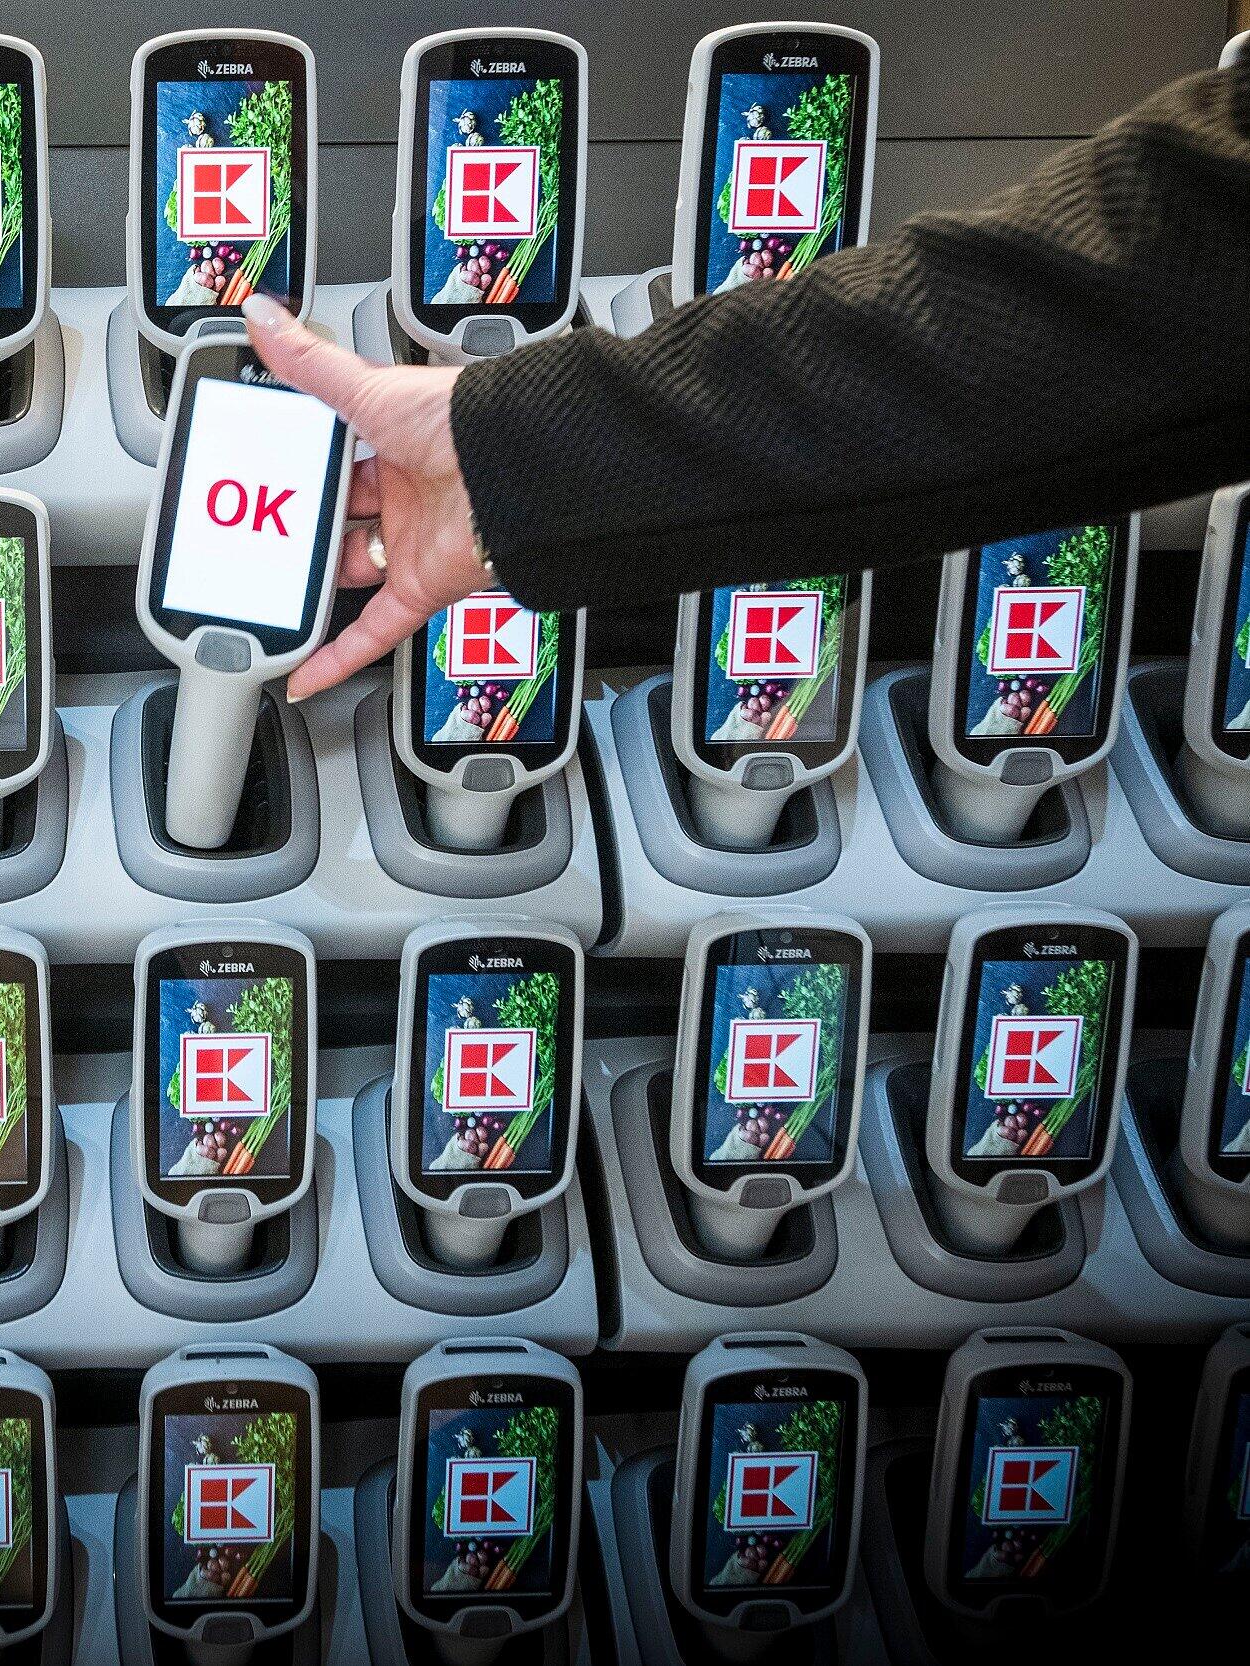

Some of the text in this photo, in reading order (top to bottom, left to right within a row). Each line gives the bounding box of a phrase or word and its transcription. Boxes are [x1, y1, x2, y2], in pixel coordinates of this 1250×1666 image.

[780, 56, 819, 68] ZEBRA
[215, 63, 254, 75] ZEBRA
[488, 62, 526, 74] ZEBRA
[206, 479, 297, 537] OK
[775, 948, 812, 959] ZEBRA
[1040, 944, 1078, 955] ZEBRA
[217, 962, 255, 973] ZEBRA
[486, 957, 524, 968] ZEBRA
[771, 1386, 808, 1398] ZEBRA
[1036, 1382, 1073, 1392] ZEBRA
[222, 1398, 259, 1409] ZEBRA
[487, 1393, 524, 1403] ZEBRA
